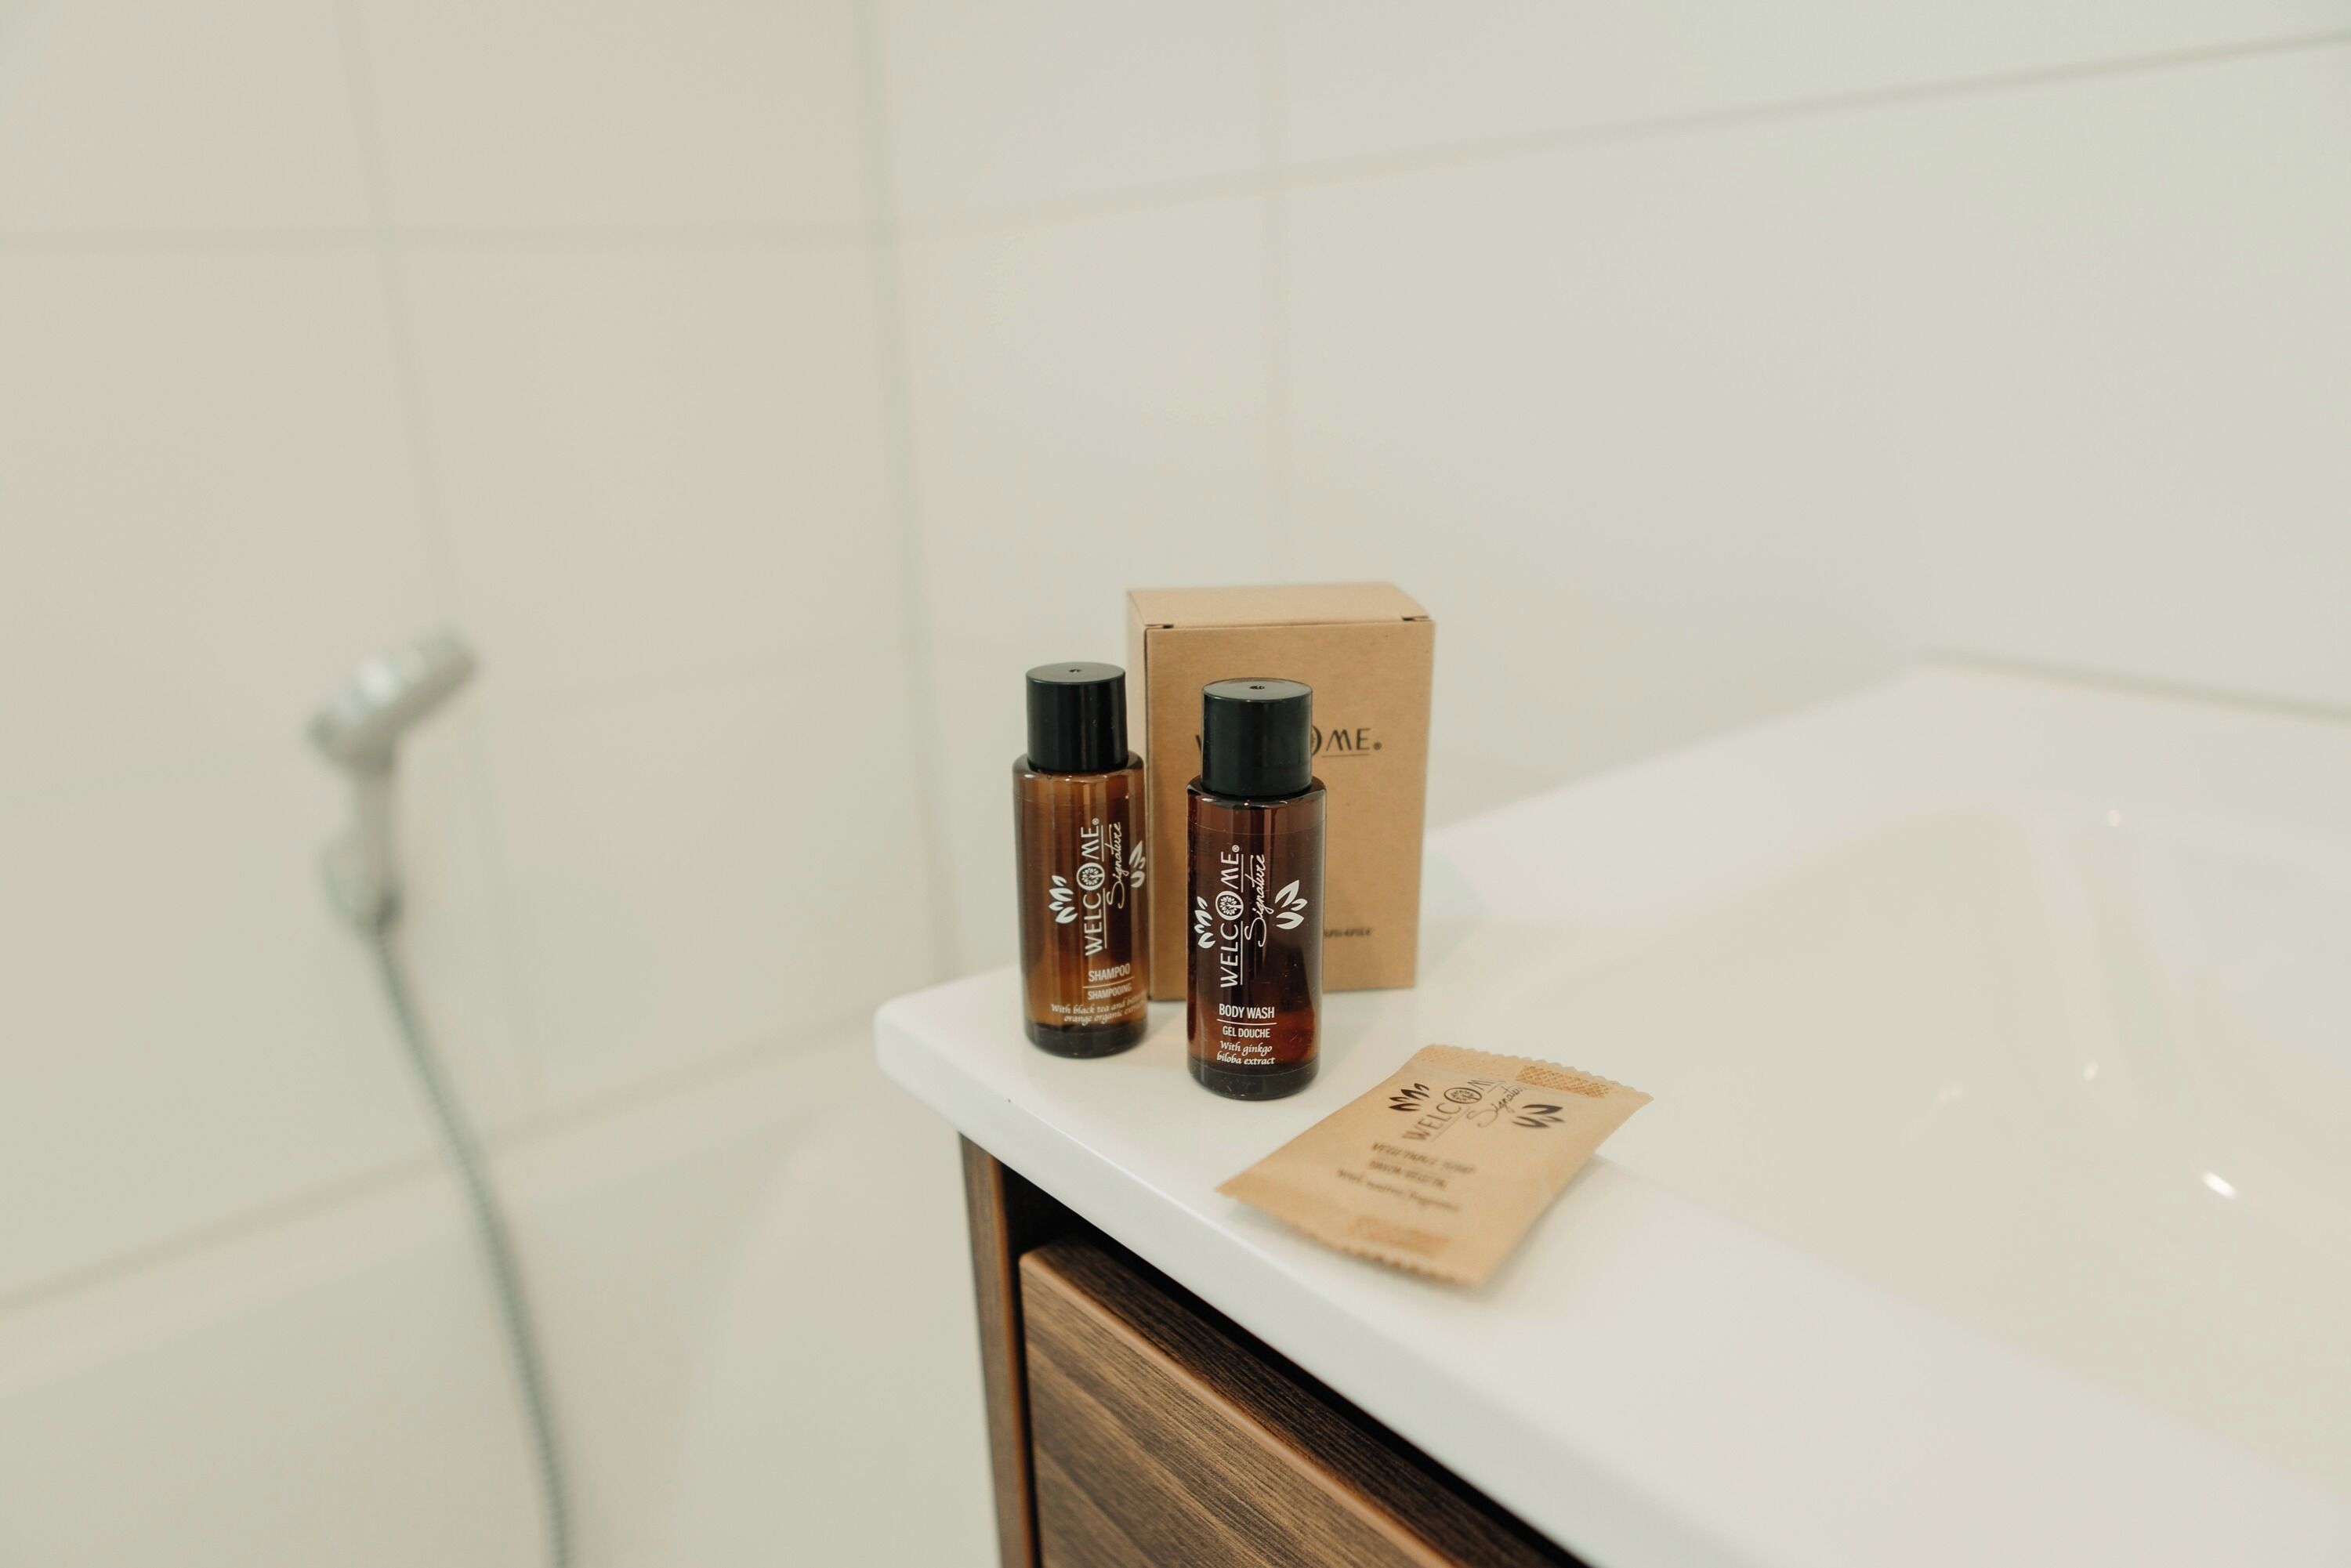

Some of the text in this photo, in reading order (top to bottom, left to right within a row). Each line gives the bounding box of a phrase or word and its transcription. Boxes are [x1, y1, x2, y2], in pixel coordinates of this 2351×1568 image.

[1106, 821, 1129, 909] Signature
[1244, 853, 1274, 947] Signature
[1088, 963, 1131, 983] SHAMPOO
[1087, 983, 1132, 1001] SHAMPOOING
[1051, 1004, 1070, 1013] With
[1073, 1004, 1096, 1014] black
[1111, 998, 1127, 1011] and
[1219, 1003, 1275, 1019] BODY WASH
[1063, 1009, 1123, 1026] orange organic
[1223, 1025, 1271, 1038] GEL DOUCHE
[1219, 1040, 1273, 1056] With ginkgo
[1216, 1051, 1242, 1064] biloba
